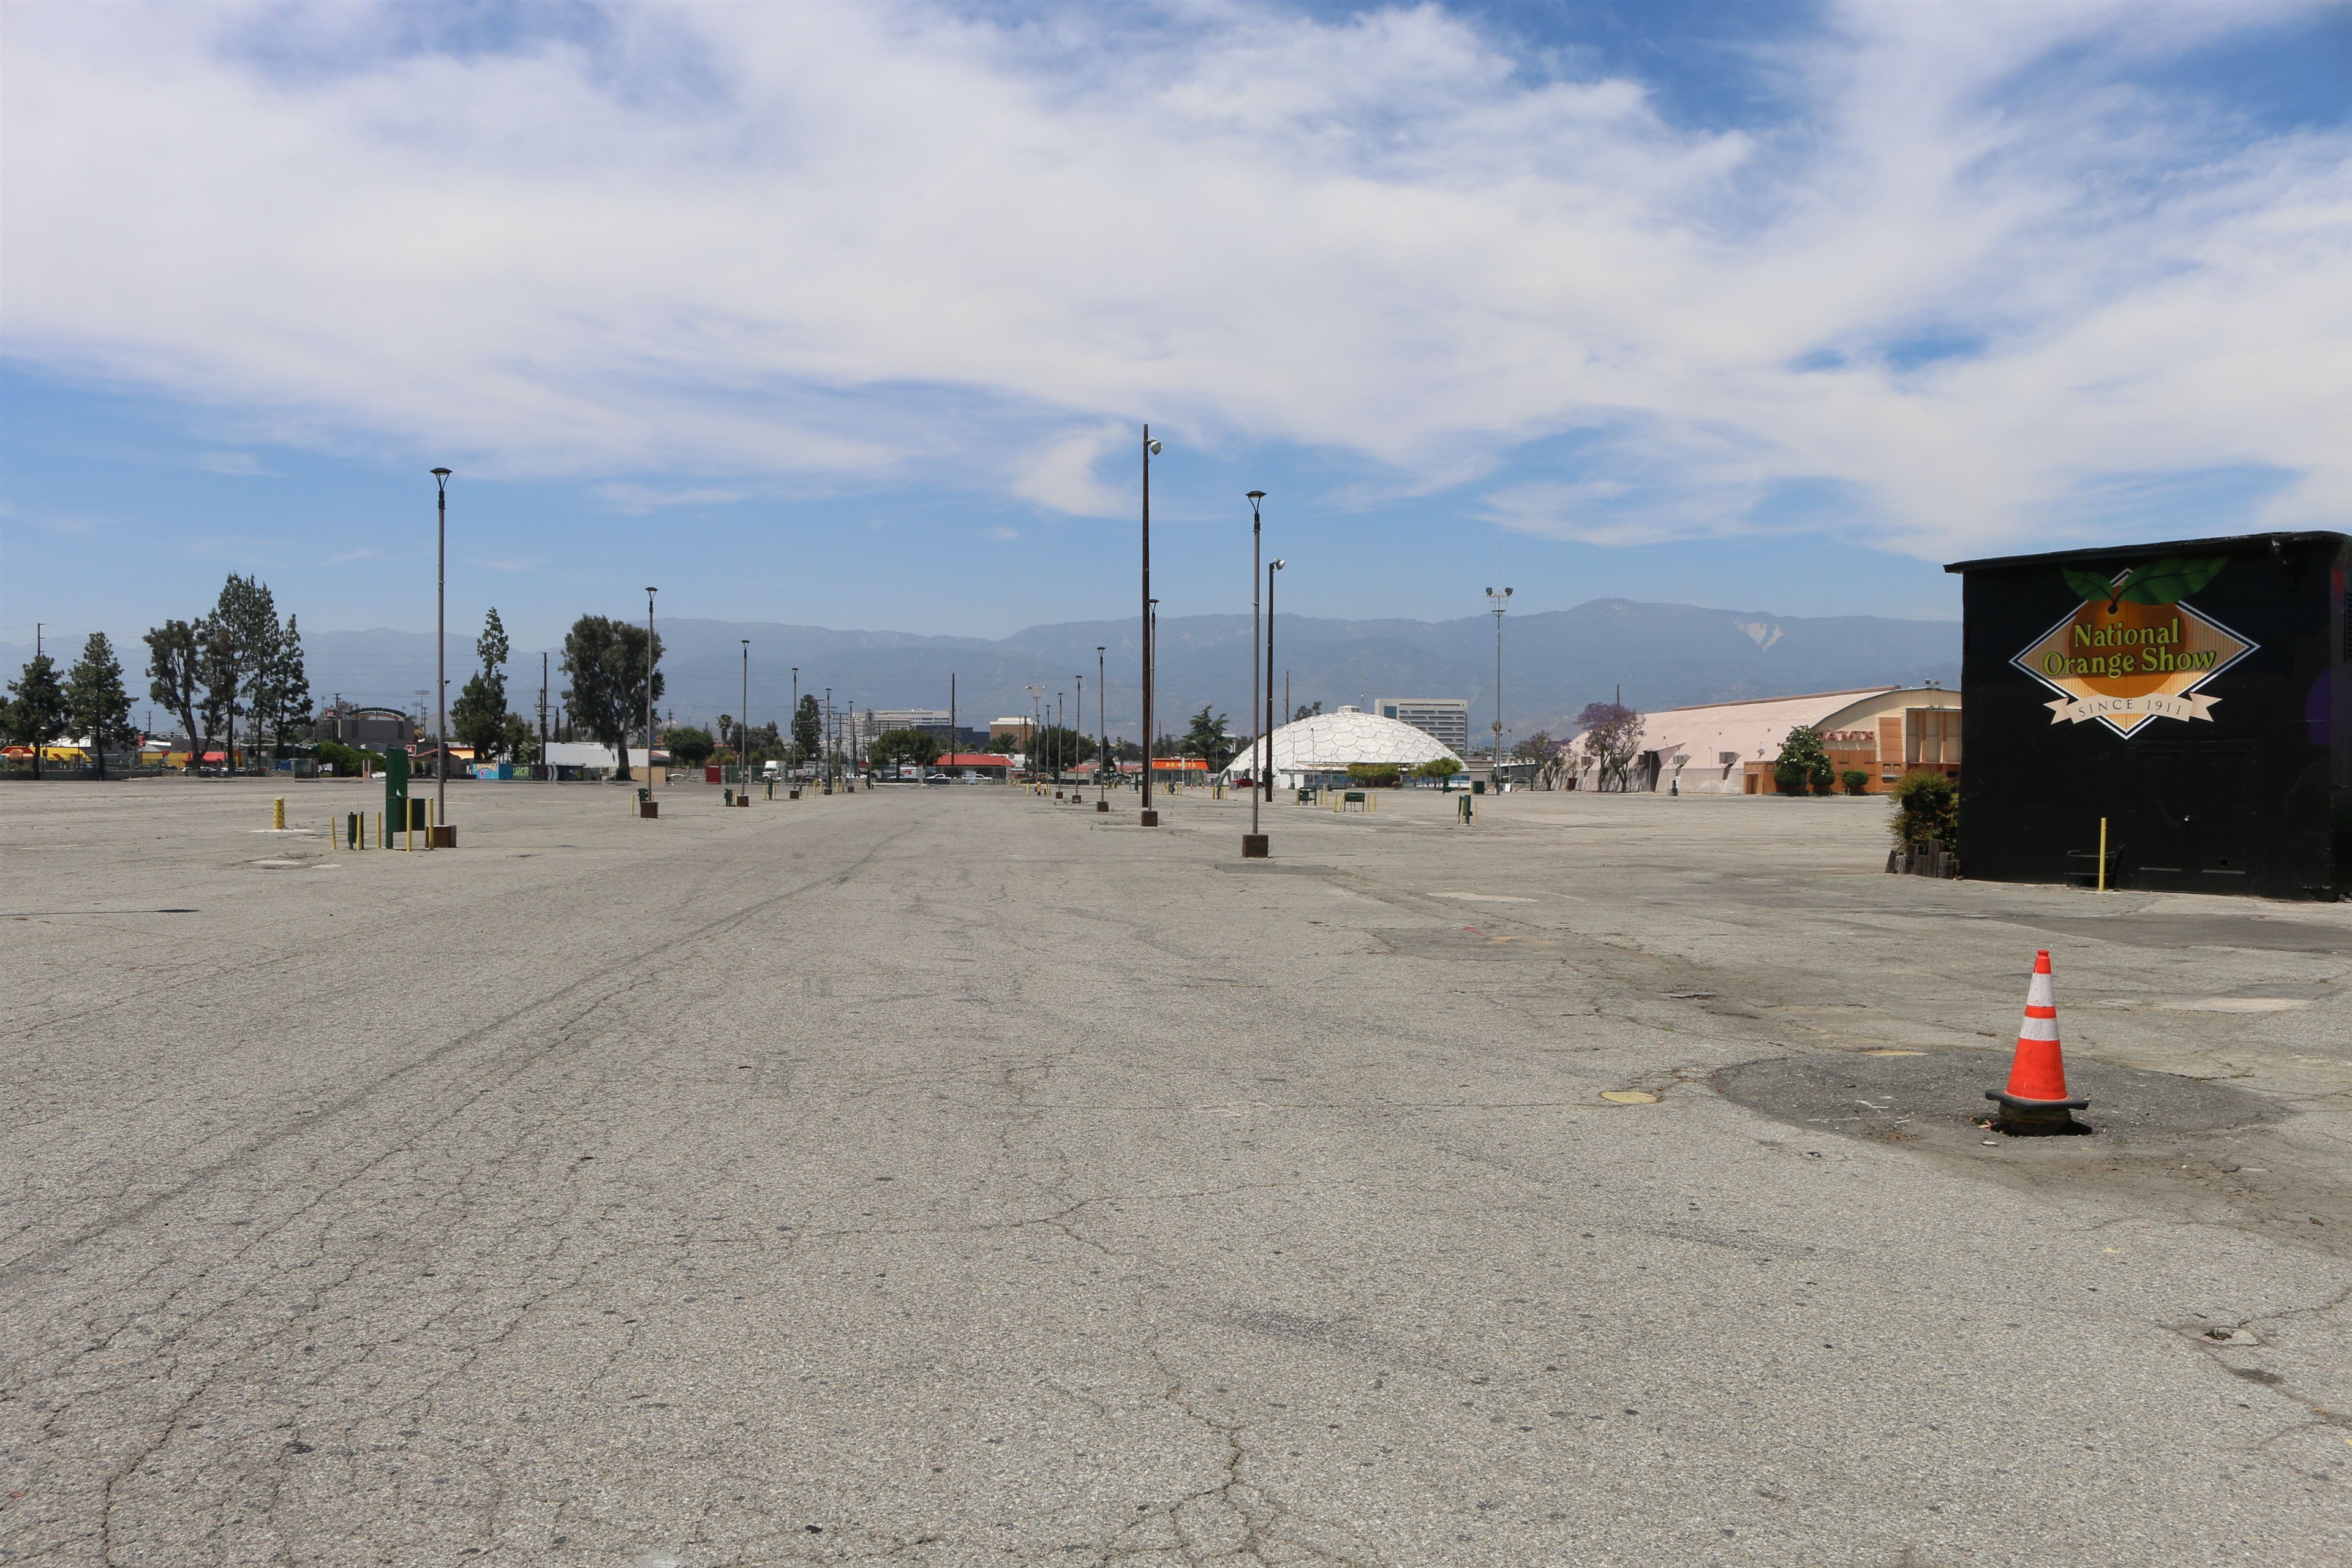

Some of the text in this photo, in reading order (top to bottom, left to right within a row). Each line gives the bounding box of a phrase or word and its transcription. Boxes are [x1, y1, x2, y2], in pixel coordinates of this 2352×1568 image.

[2074, 617, 2180, 648] National
[2043, 646, 2217, 679] Orange Show
[2078, 698, 2182, 717] SINCE 1911
